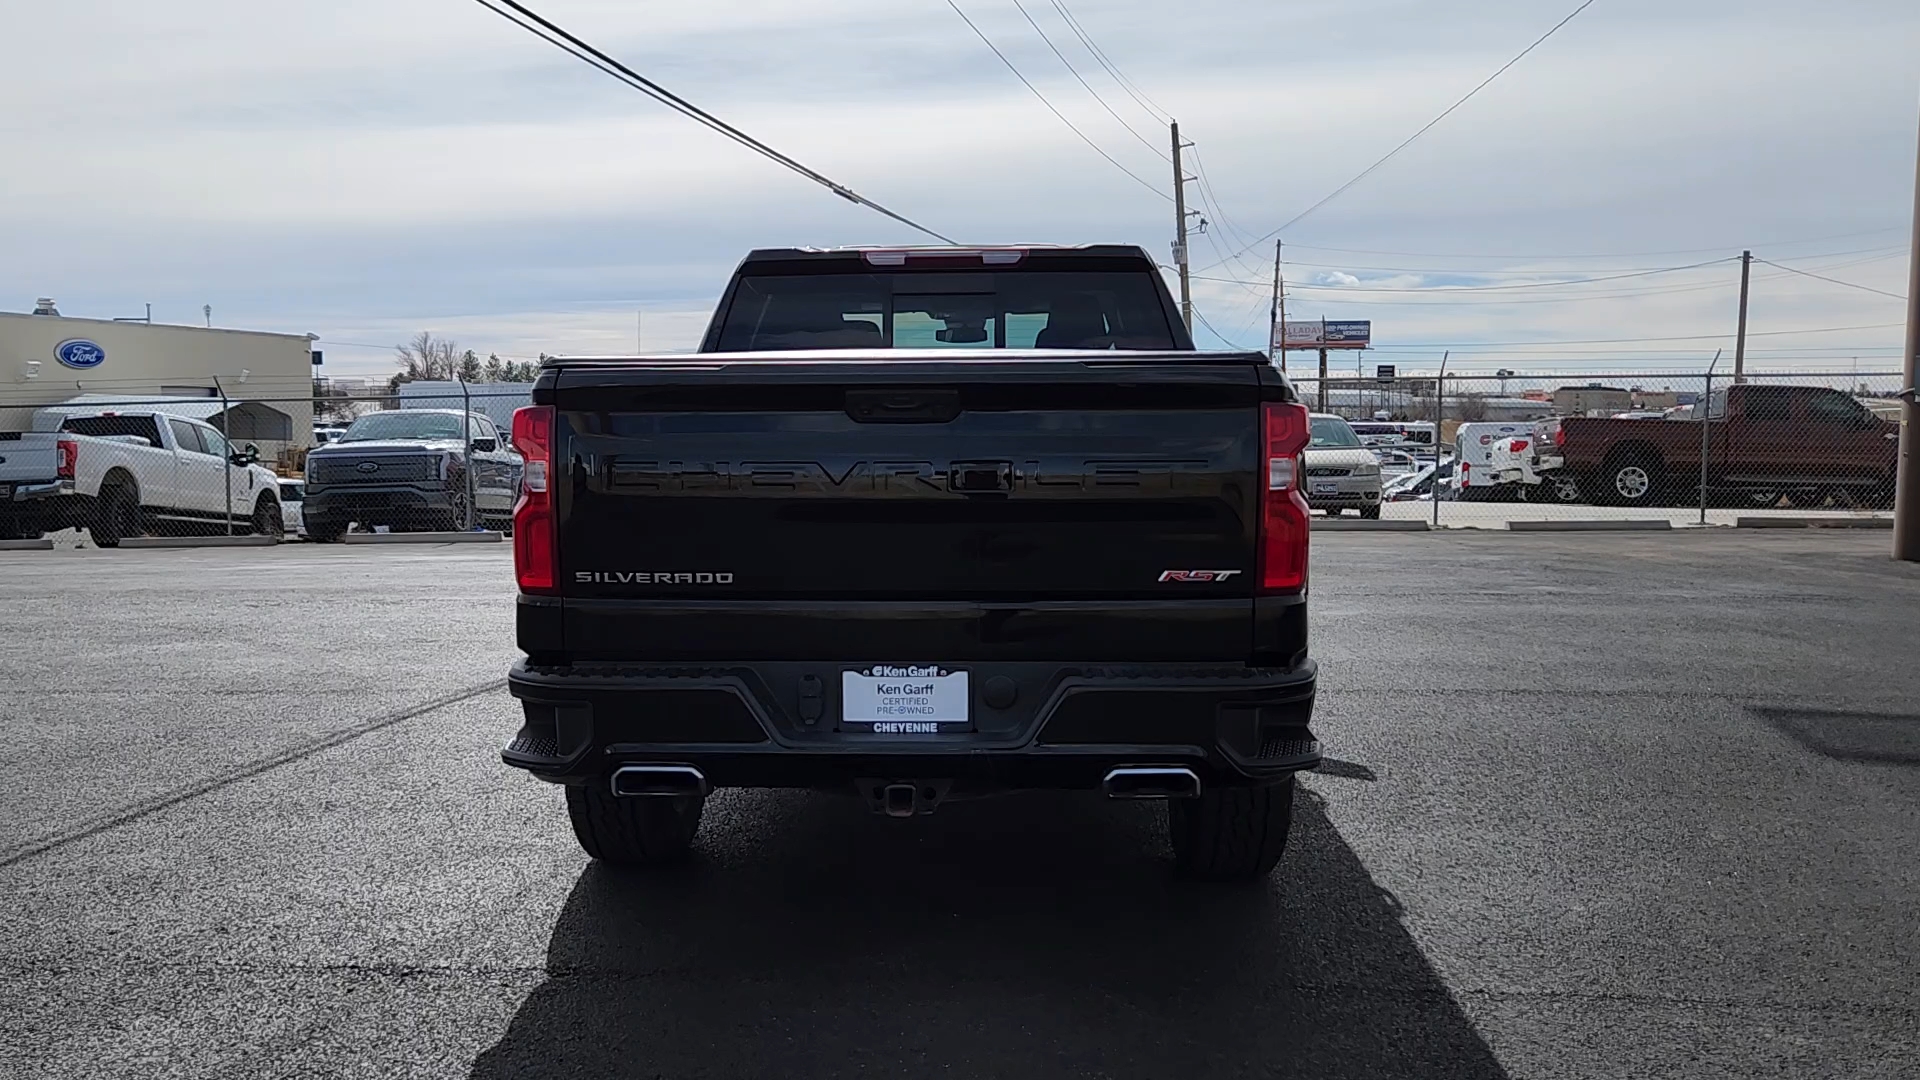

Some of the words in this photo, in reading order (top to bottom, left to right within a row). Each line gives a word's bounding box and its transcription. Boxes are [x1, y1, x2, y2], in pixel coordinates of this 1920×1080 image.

[70, 345, 98, 362] Ford
[600, 460, 1209, 492] CHEVROLET
[575, 571, 733, 584] SILVERADO
[1158, 570, 1242, 582] RST
[883, 665, 907, 677] Ken
[907, 665, 939, 677] Garff
[877, 683, 901, 695] Ken
[903, 683, 934, 695] Garff
[882, 697, 929, 706] CERTIFIED
[877, 706, 934, 715] PRE-OWNED
[873, 722, 938, 733] CHEYENNE
